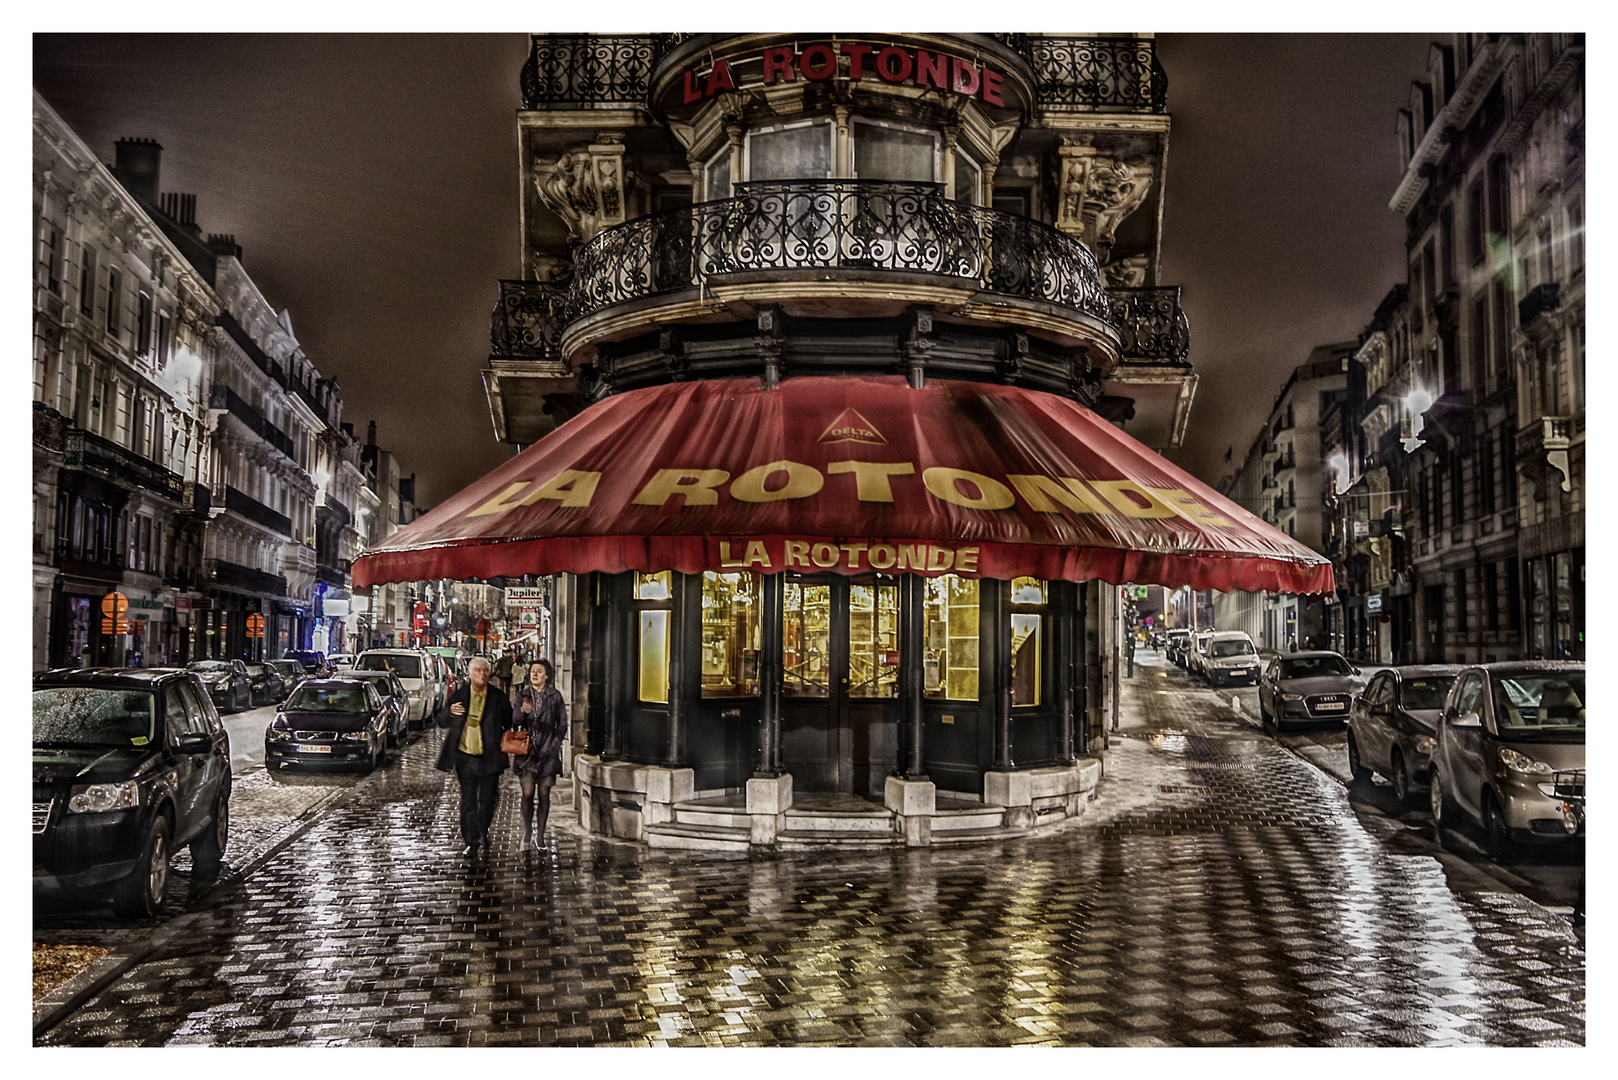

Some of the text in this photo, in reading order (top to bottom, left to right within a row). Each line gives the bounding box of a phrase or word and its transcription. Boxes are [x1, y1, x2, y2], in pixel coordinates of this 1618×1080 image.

[683, 44, 1005, 108] LA ROTONDE
[831, 426, 875, 437] DELTA
[464, 460, 1236, 528] LA ROTONDE
[719, 540, 980, 573] LA ROTONDE
[508, 588, 542, 599] Jupiler
